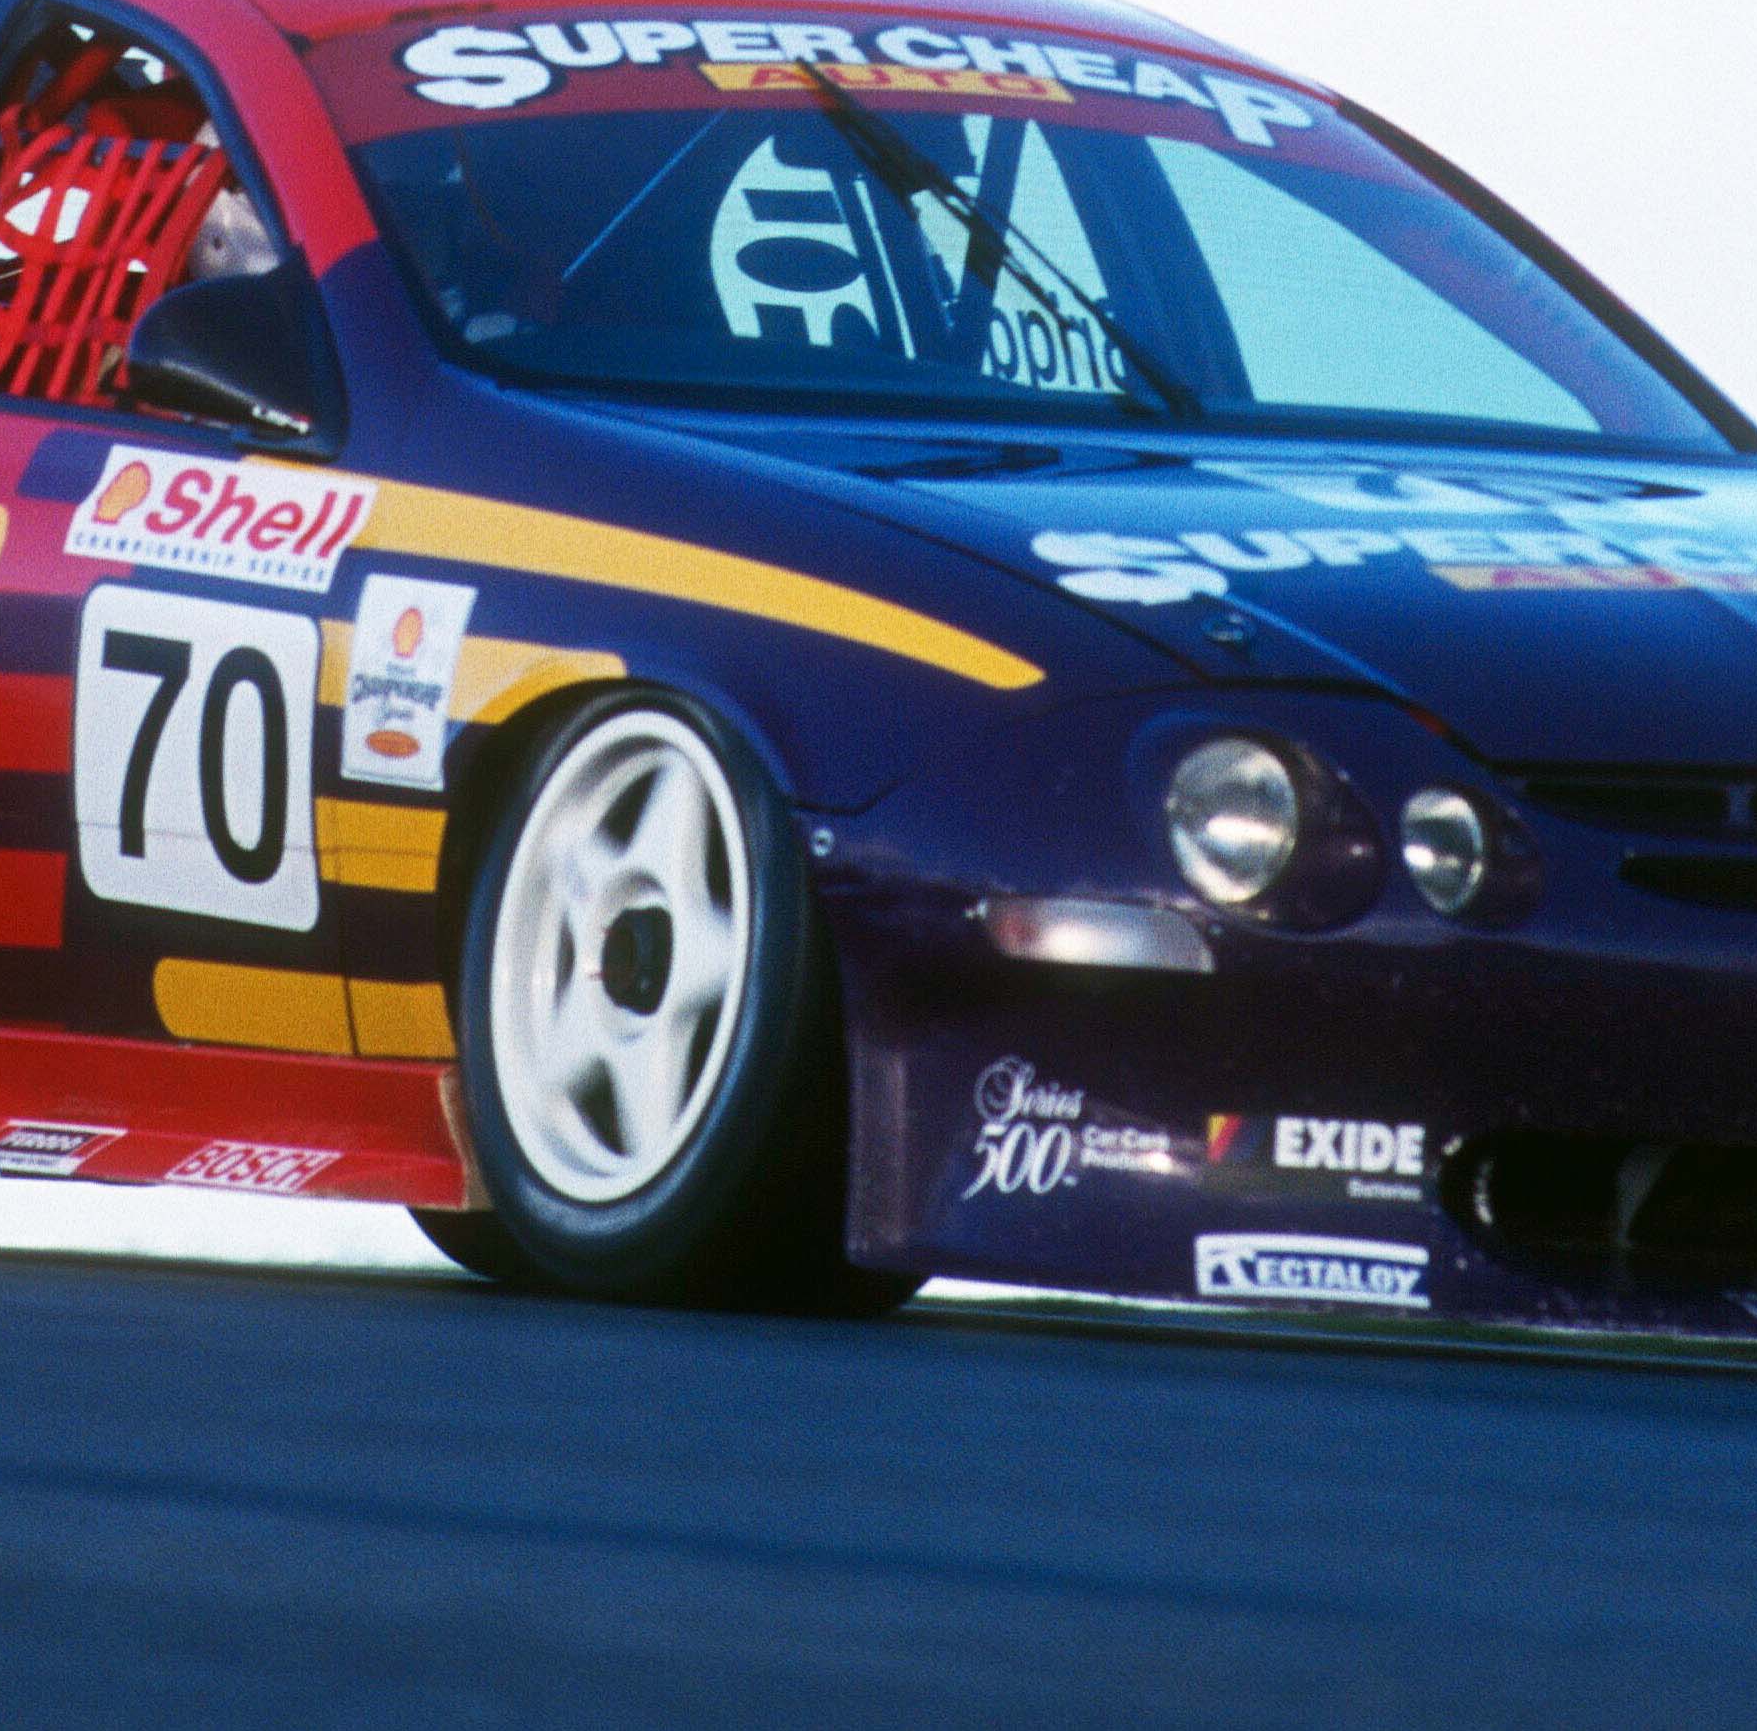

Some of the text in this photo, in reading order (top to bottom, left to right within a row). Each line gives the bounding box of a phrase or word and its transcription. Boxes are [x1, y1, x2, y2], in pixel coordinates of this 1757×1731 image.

[403, 20, 1314, 148] SUPER CHEAP
[747, 67, 1047, 96] AUTO
[145, 468, 364, 559] Shell
[74, 531, 326, 583] CHAMPIONSHIP SERIES
[102, 629, 289, 884] 70
[172, 1144, 340, 1192] BOSCH
[1274, 1114, 1426, 1175] EXIDE
